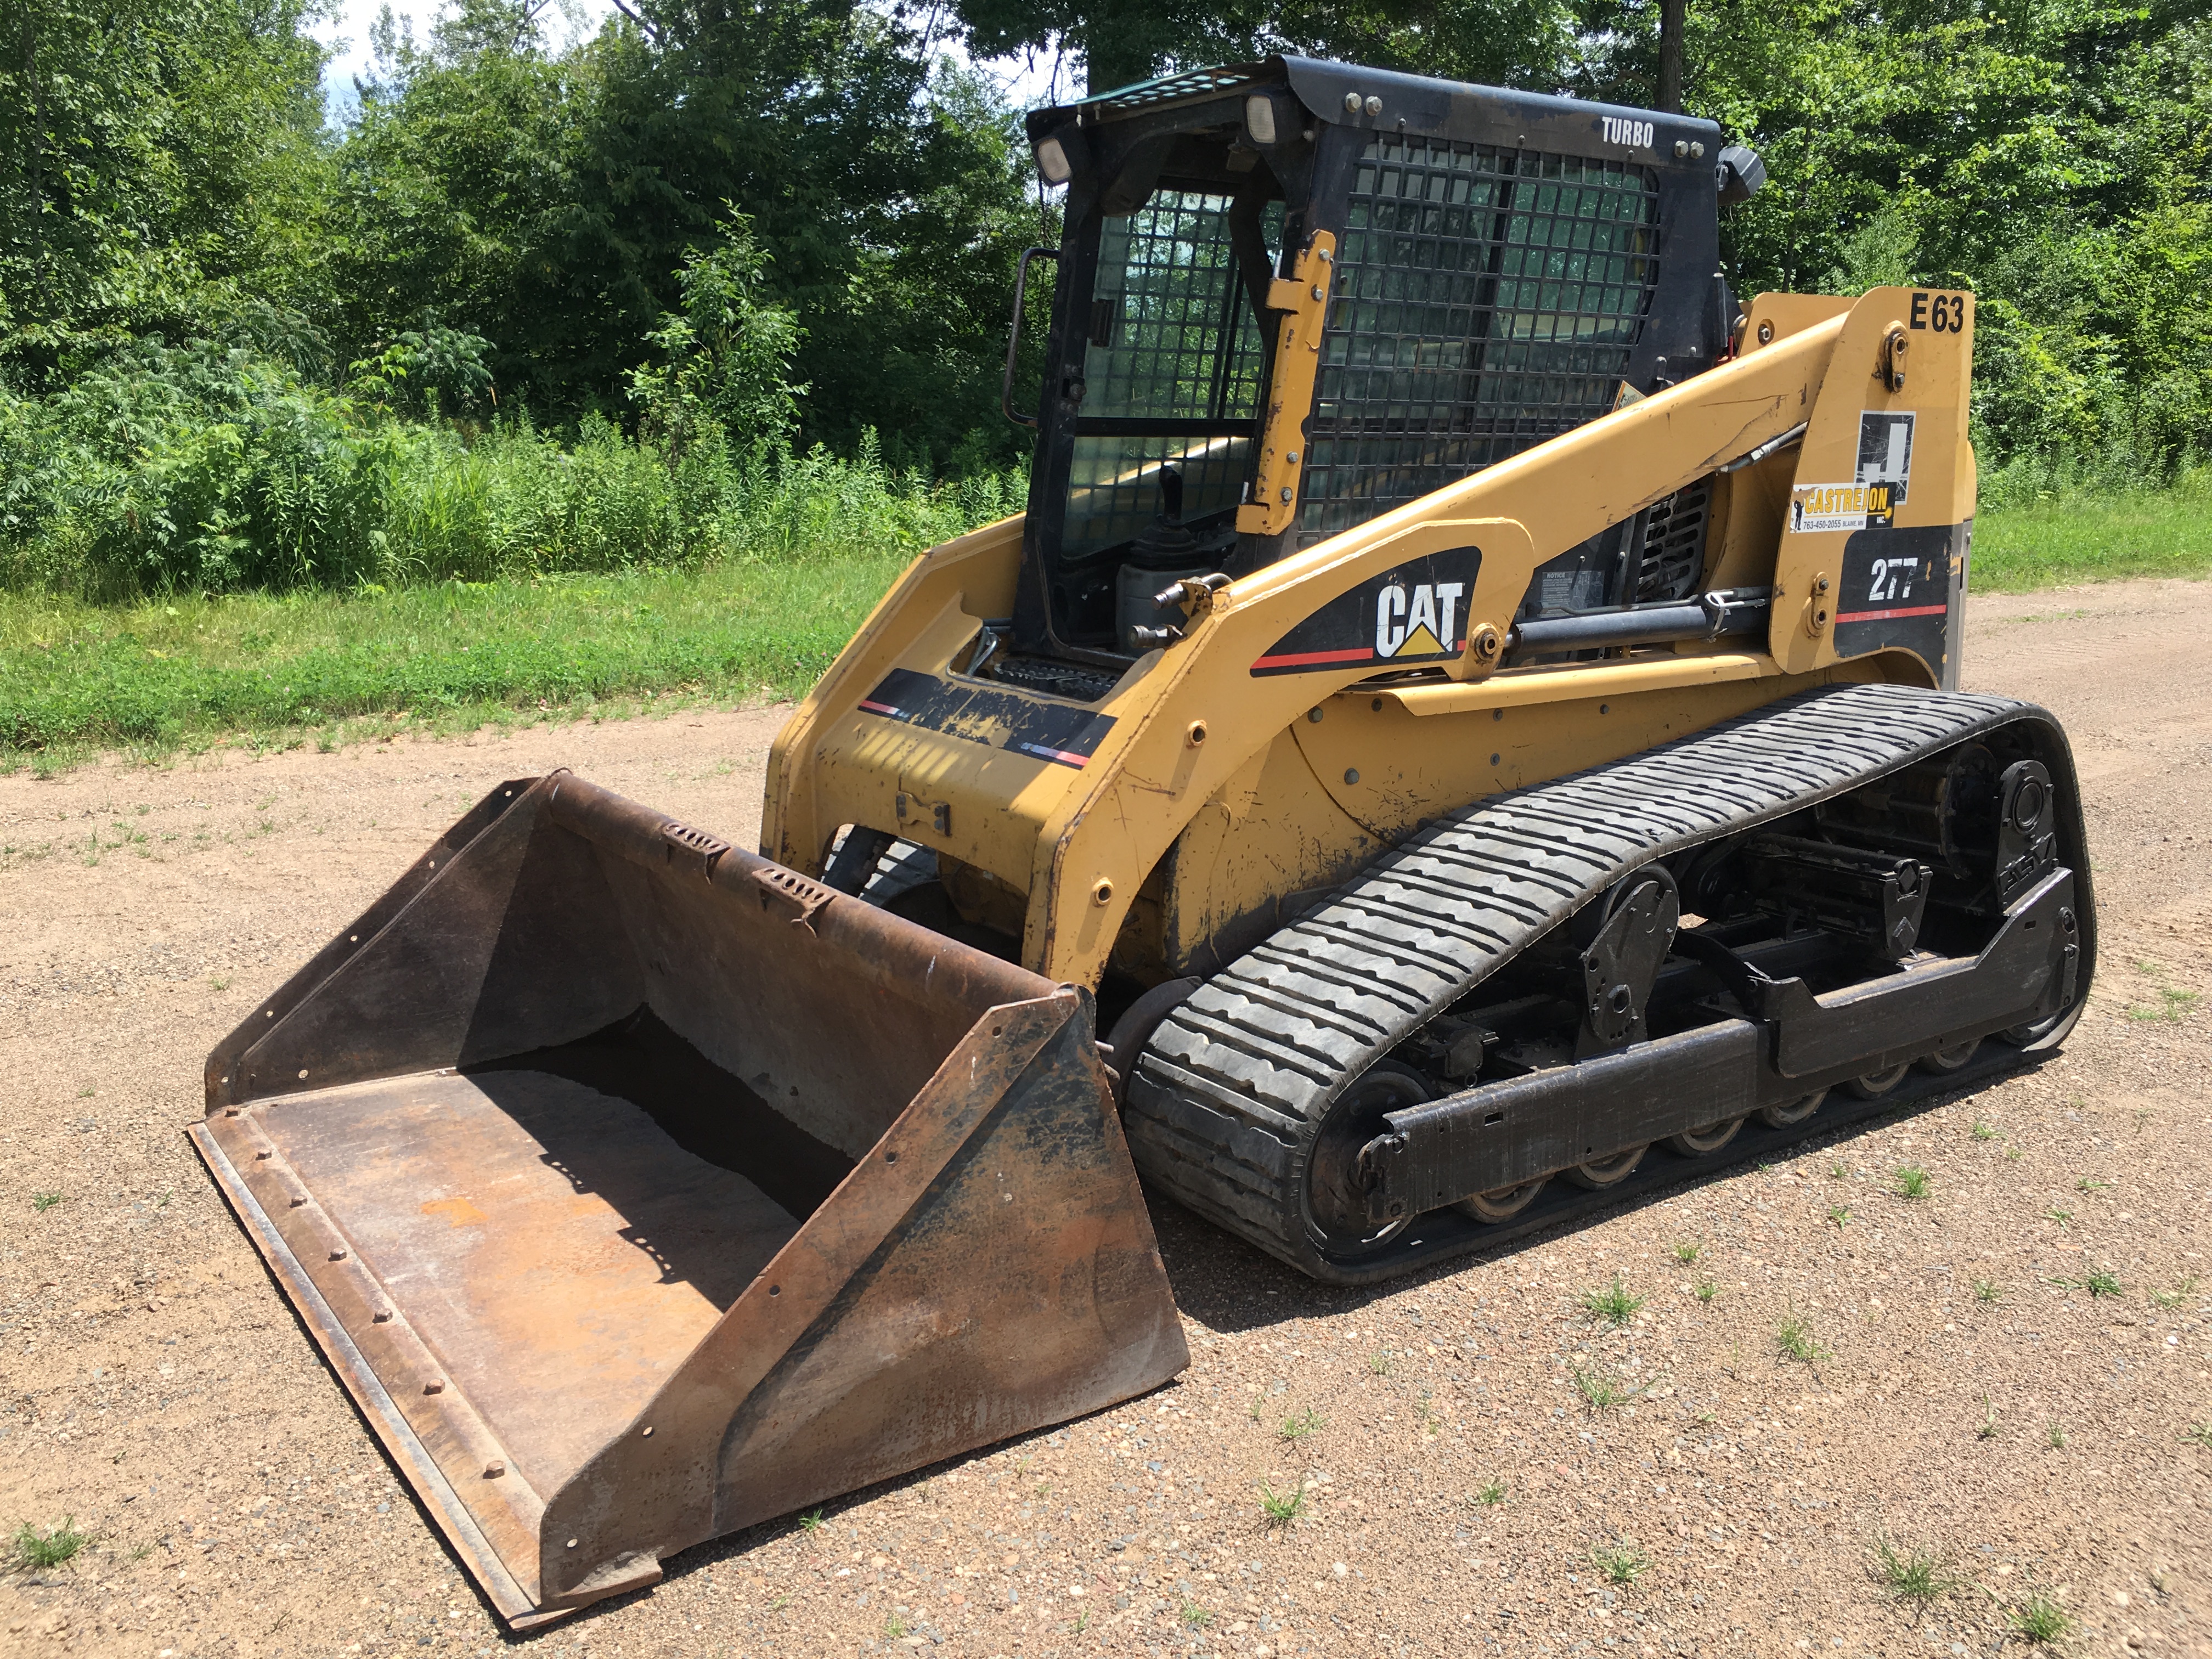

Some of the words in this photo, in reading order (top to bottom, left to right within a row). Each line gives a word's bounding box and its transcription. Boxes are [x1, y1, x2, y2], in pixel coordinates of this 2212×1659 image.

[1602, 116, 1654, 148] TURBO
[1804, 487, 1888, 514] CASTREJON
[1803, 520, 1841, 530] 763-450-2055
[1869, 557, 1918, 601] 277
[1375, 582, 1463, 658] CAT
